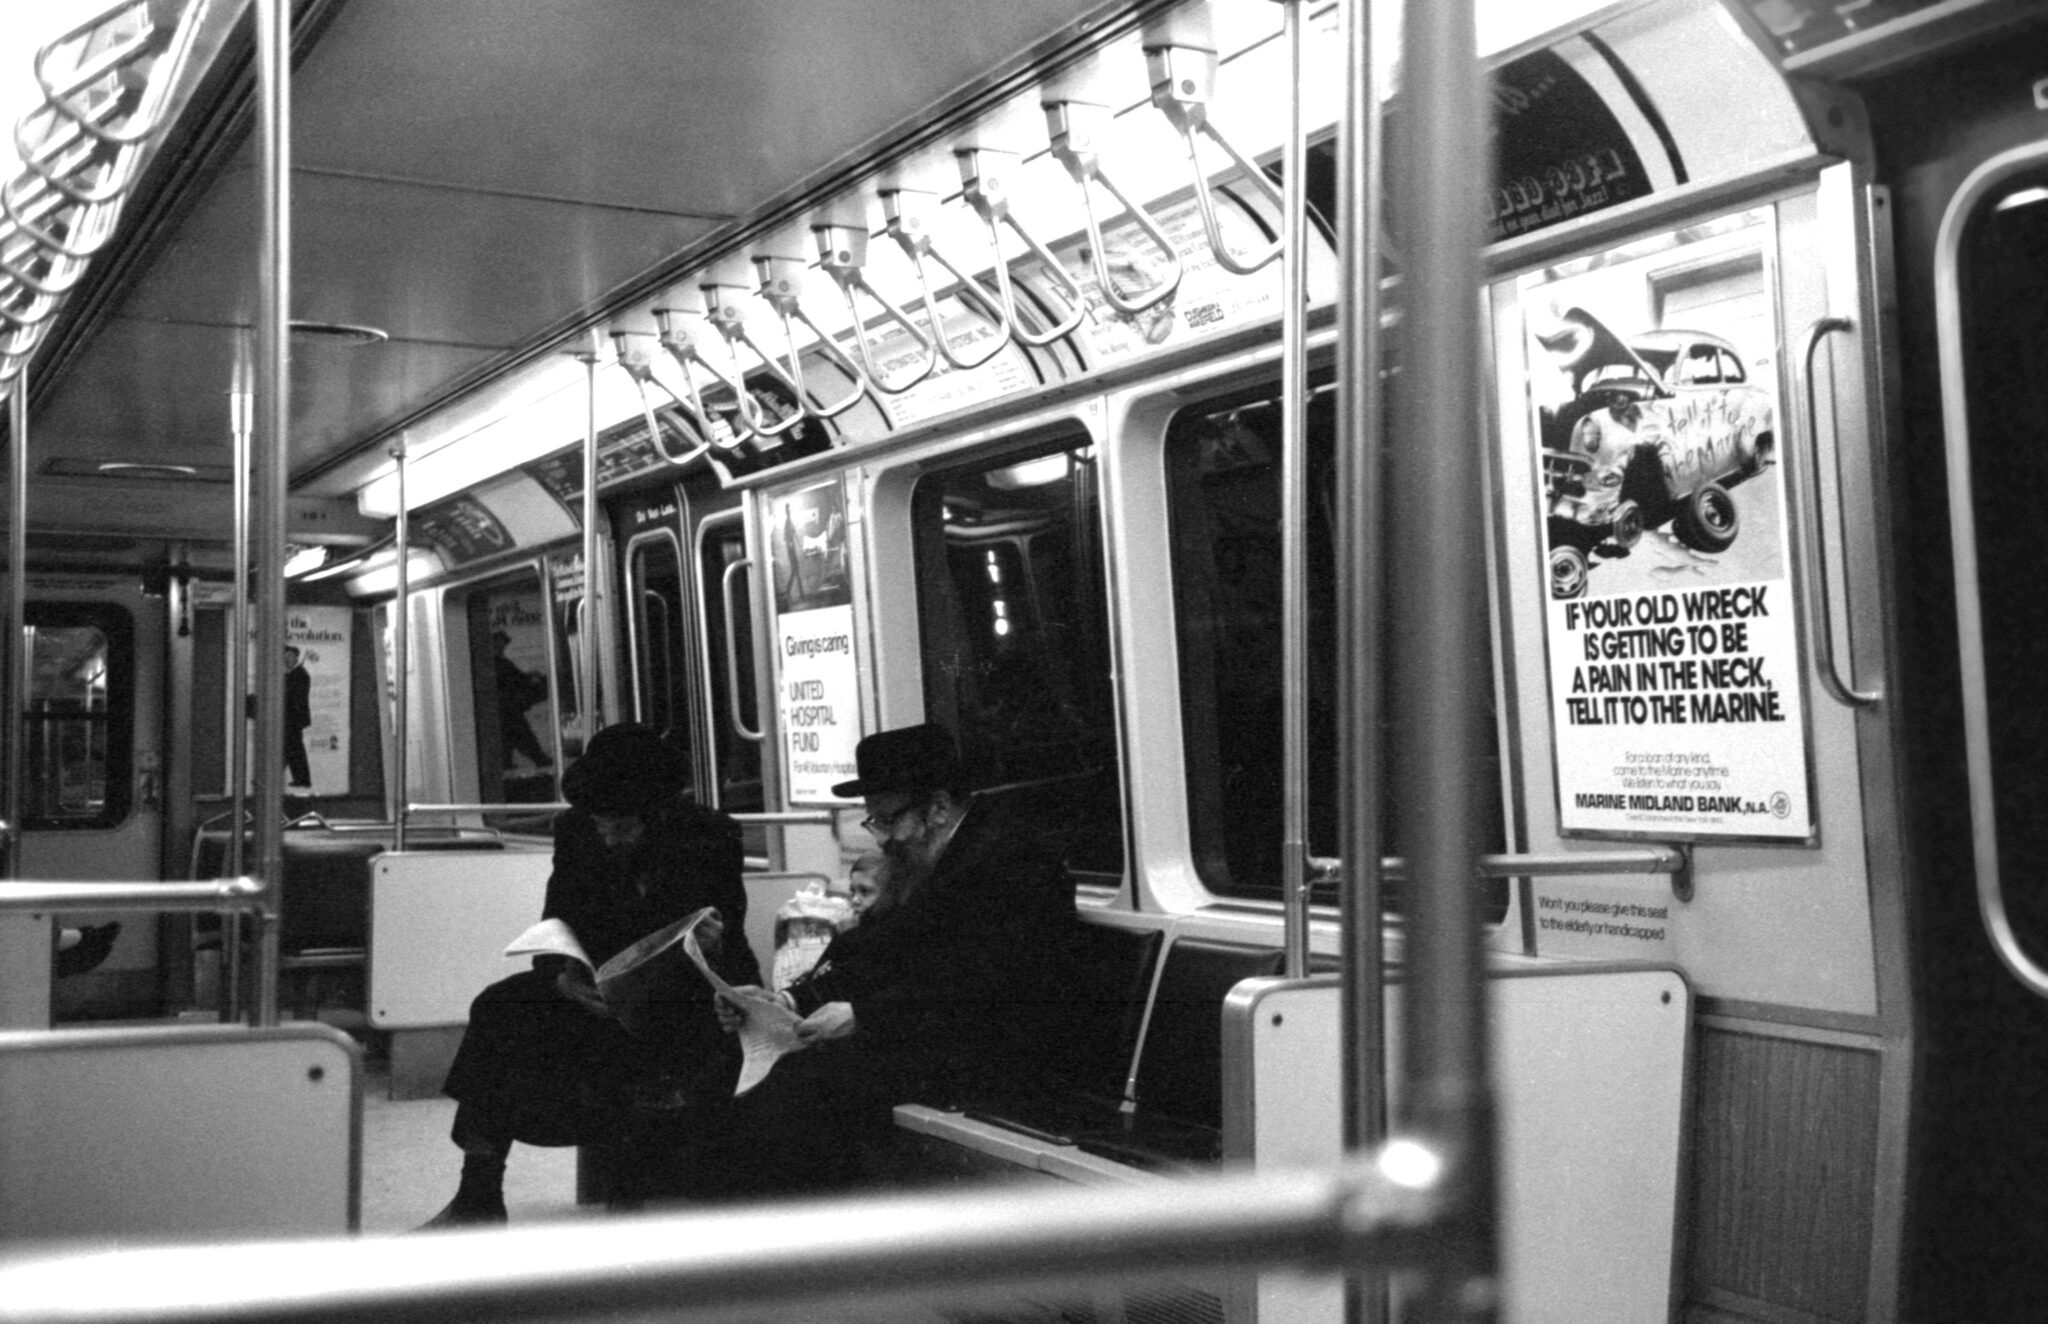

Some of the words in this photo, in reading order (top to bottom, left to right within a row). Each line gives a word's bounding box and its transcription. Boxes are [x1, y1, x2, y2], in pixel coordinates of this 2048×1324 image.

[1566, 603, 1580, 631] IF
[1581, 599, 1632, 629] YOUR
[1635, 595, 1678, 624] OLD
[1682, 586, 1769, 621] WRECK
[786, 633, 814, 658] Giving
[814, 634, 821, 653] is
[822, 632, 849, 655] caring
[1584, 633, 1600, 661] IS
[1599, 626, 1686, 659] GETTING
[1688, 625, 1716, 655] TO
[1722, 623, 1748, 652] BE
[1572, 666, 1586, 693] A
[1589, 664, 1632, 692] PAIN
[1637, 662, 1657, 691] IN
[1659, 660, 1698, 689] THE
[1702, 657, 1773, 691] NECK,
[789, 680, 824, 701] UNITED
[791, 705, 836, 726] HOSPITAL
[1567, 698, 1602, 725] TELL
[1604, 697, 1621, 725] IT
[1621, 696, 1648, 724] TO
[1649, 695, 1686, 724] THE
[1691, 692, 1786, 723] MARINE.
[792, 732, 820, 752] FUND
[1625, 751, 1638, 763] For
[1645, 752, 1663, 763] loan
[1613, 767, 1638, 776] come
[1647, 766, 1662, 776] the
[1662, 766, 1692, 777] Marine
[1666, 779, 1687, 789] what
[1689, 780, 1705, 791] you
[1576, 794, 1626, 809] MARINE
[1629, 795, 1694, 812] MIDLAND
[1564, 901, 1580, 913] you
[1581, 899, 1611, 914] please
[1611, 902, 1629, 917] give
[1631, 904, 1646, 917] this
[1647, 906, 1668, 919] seat
[1540, 917, 1549, 929] to
[1550, 918, 1564, 930] the
[1565, 920, 1594, 935] elderly
[1594, 923, 1603, 933] or
[1604, 922, 1665, 940] handicapped
